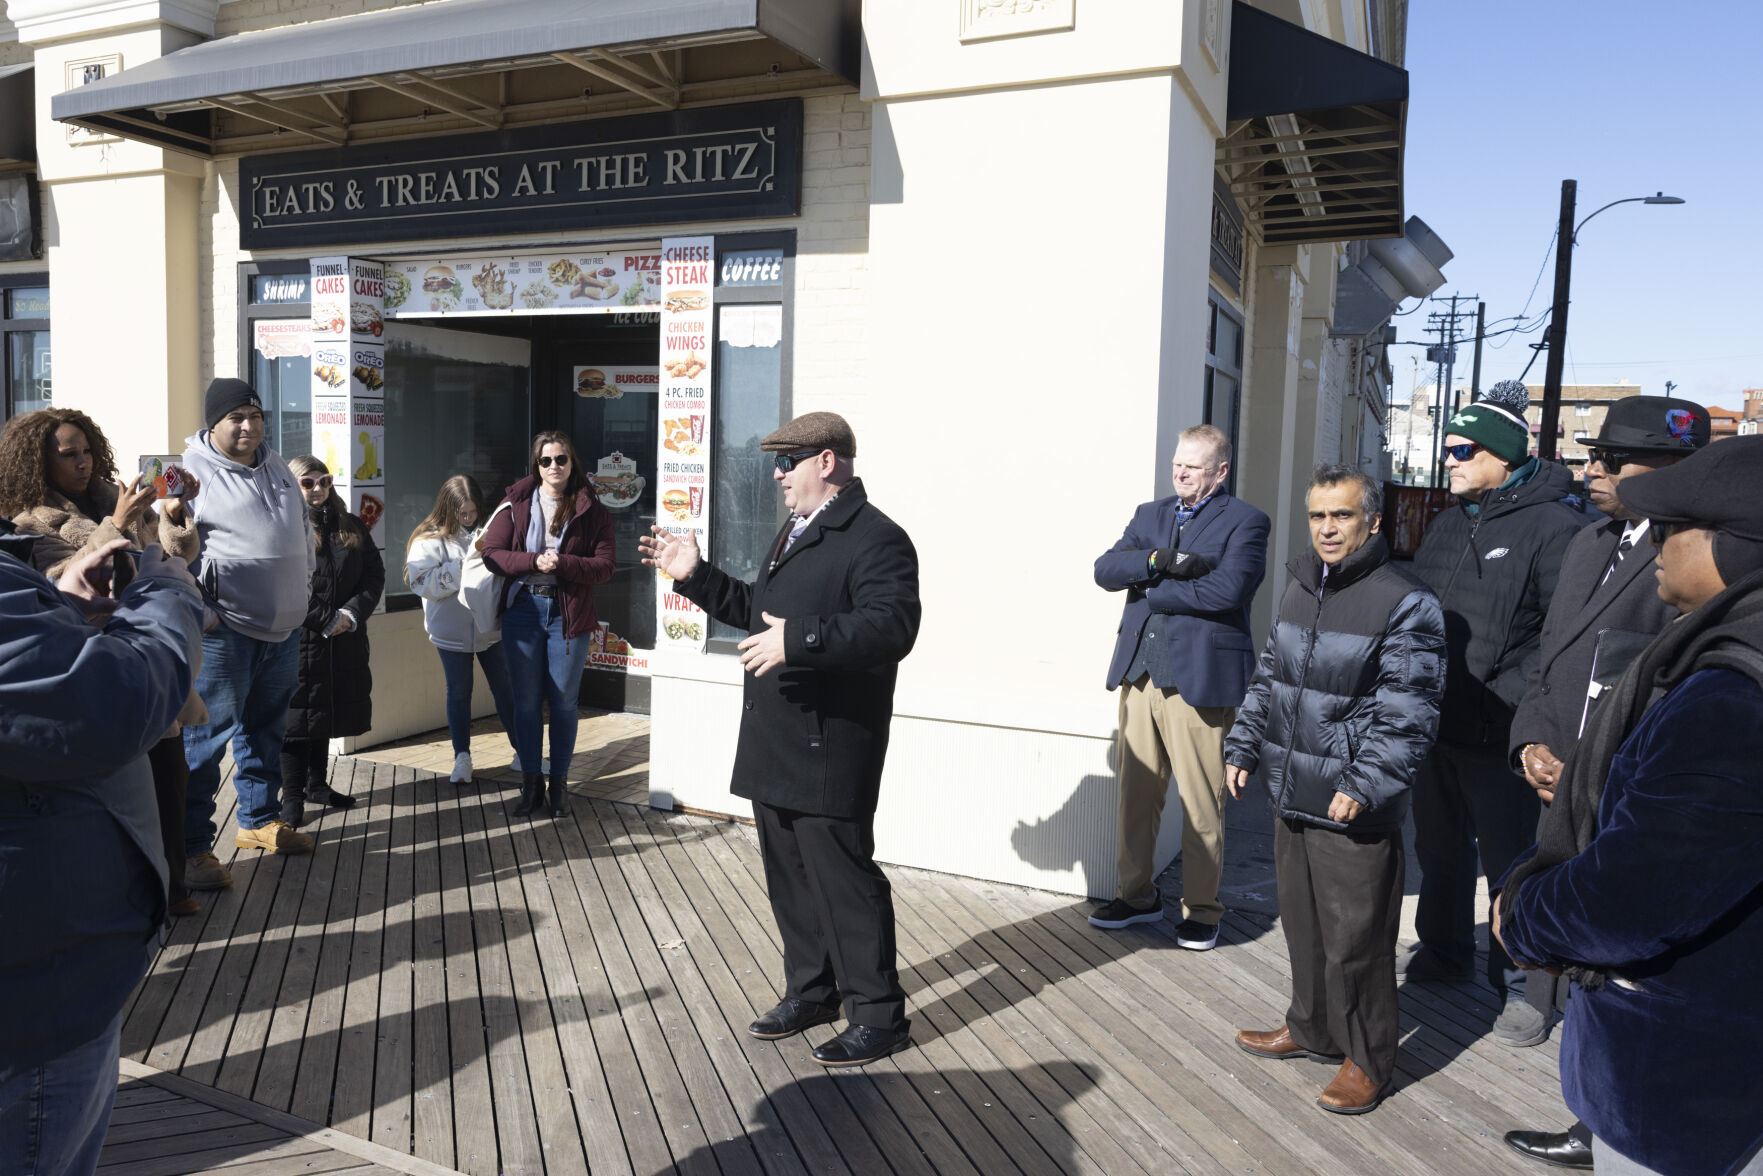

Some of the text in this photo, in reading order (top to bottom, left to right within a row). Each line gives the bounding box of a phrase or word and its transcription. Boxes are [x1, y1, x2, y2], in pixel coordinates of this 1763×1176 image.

[263, 142, 759, 217] EATS & TREATS AT THE RITZ
[666, 245, 710, 264] CHEESE
[316, 263, 344, 277] FUNNEL
[624, 255, 662, 271] PIZZ
[721, 256, 783, 282] COFFEE
[355, 265, 383, 280] FUNNEL
[667, 265, 708, 285] STEAK
[263, 279, 306, 301] SHRIMP
[315, 277, 345, 294] CAKES
[353, 278, 384, 298] CAKES
[668, 321, 704, 333] CHICKEN
[666, 335, 705, 350] WINGS
[316, 350, 346, 365] OREO
[355, 351, 384, 369] OREO
[615, 374, 660, 384] BURGERS
[665, 387, 705, 398] 4 PC. FRIED
[664, 400, 705, 409] CHICKEN COMBO
[315, 412, 346, 425] LEMONADE
[354, 413, 384, 426] LEMONADE
[663, 462, 705, 473] FRIED CHICKEN
[663, 474, 705, 484] SANDWICH COMBO
[683, 527, 704, 535] CHKEN
